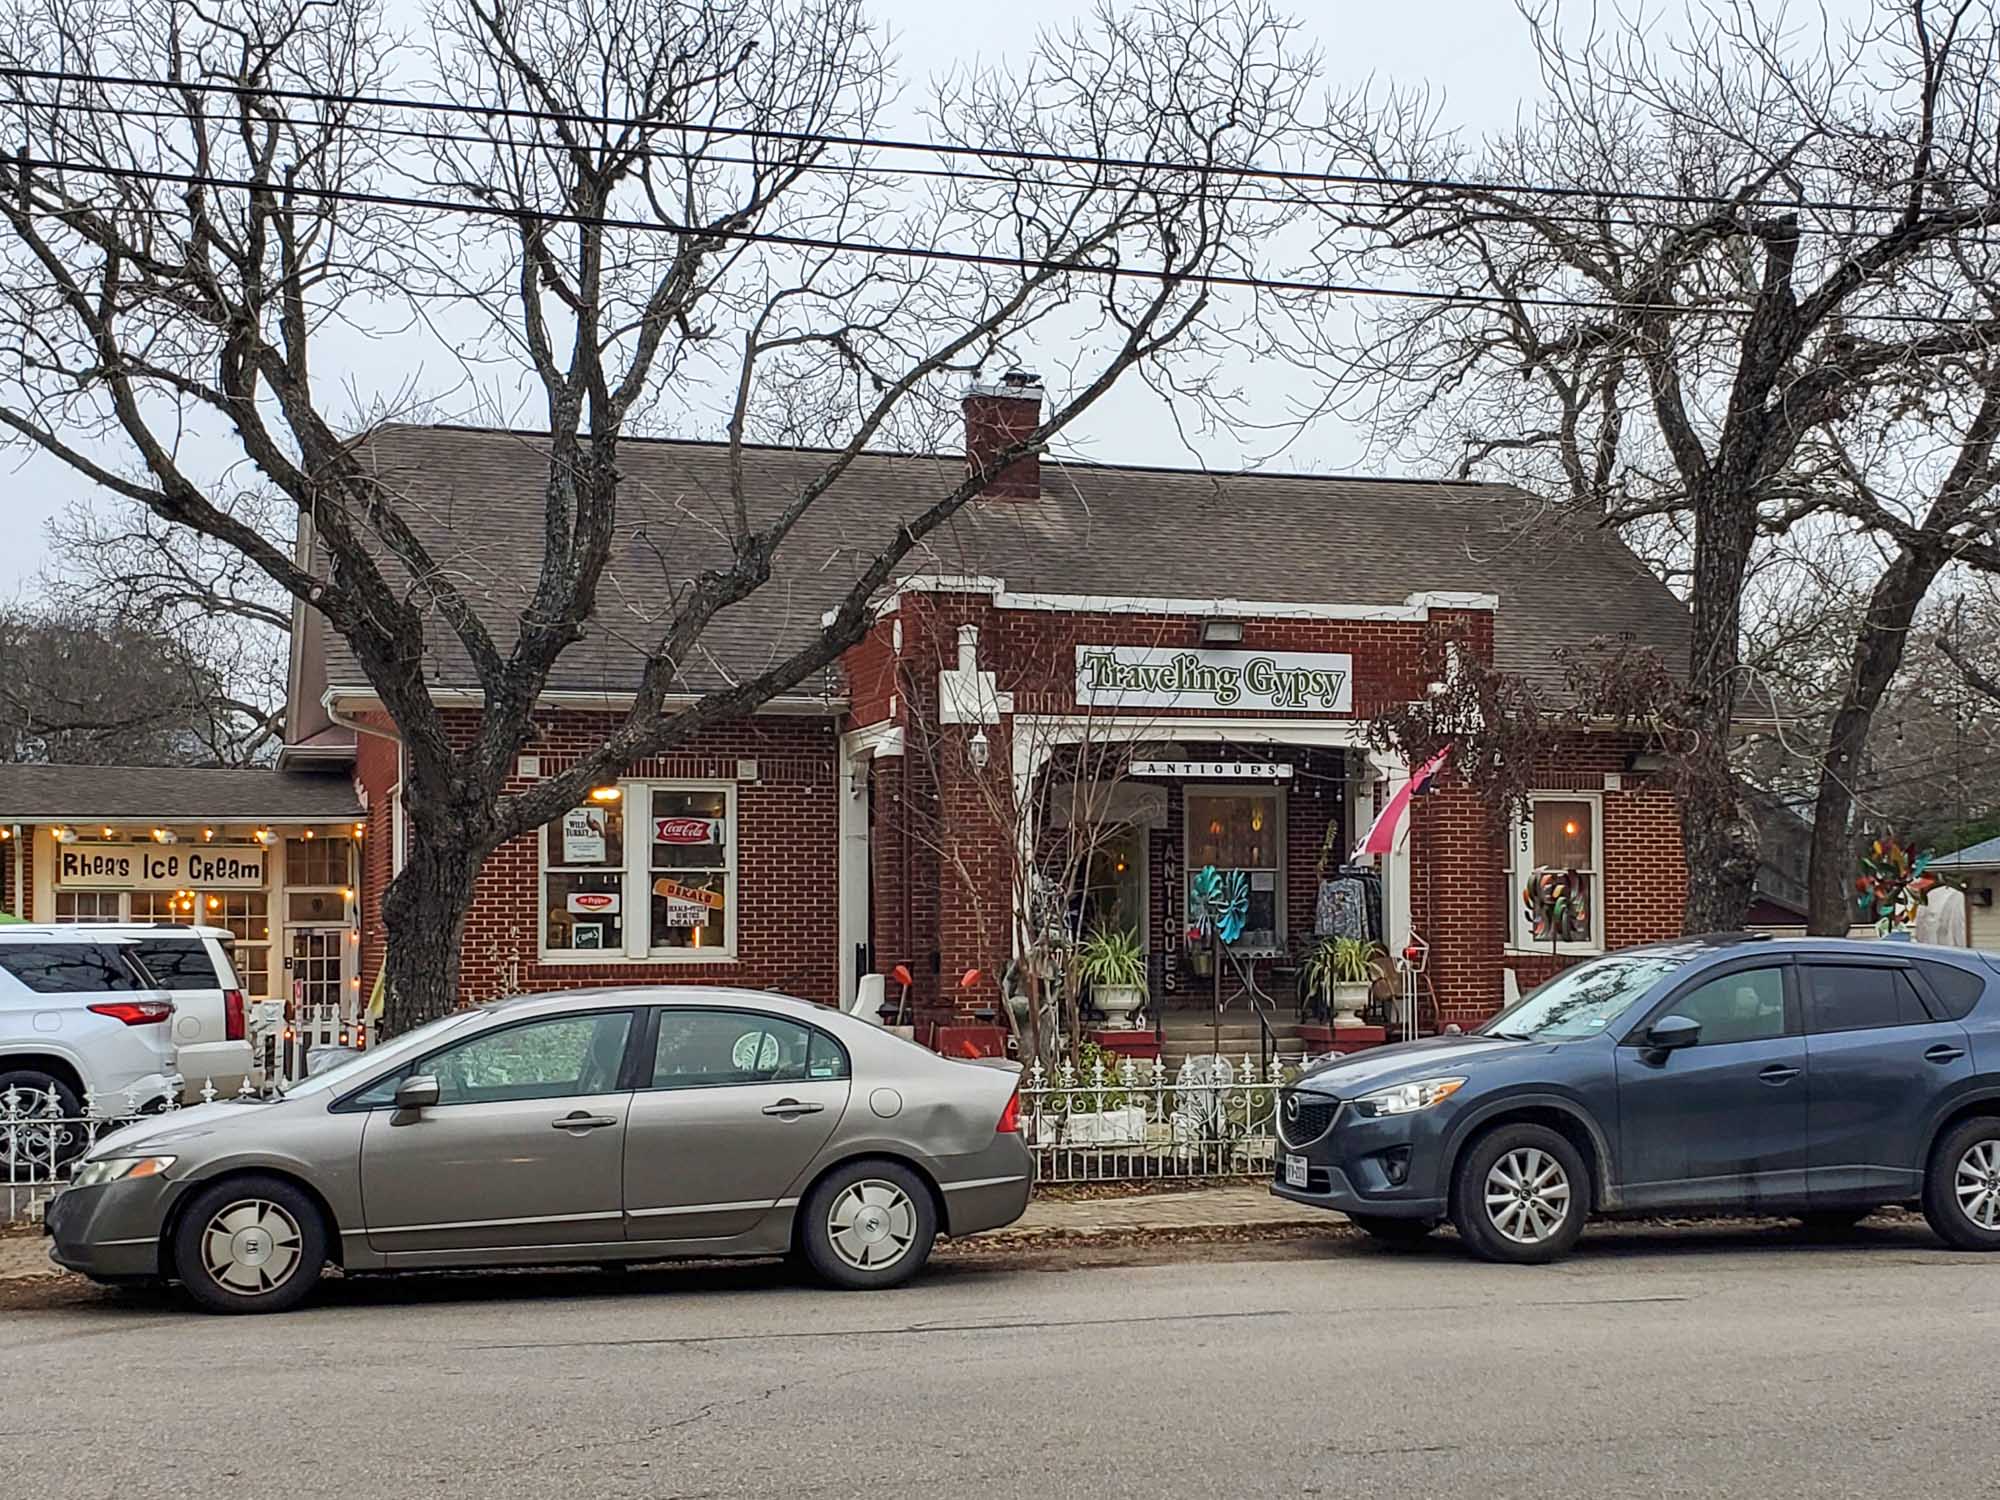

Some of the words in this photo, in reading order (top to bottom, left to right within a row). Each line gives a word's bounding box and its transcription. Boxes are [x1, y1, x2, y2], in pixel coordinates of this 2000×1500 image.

[1083, 651, 1241, 705] Traveling
[1244, 656, 1346, 708] Gypsy
[1147, 762, 1276, 776] ANTIQUES
[63, 853, 130, 877] Rhea's
[143, 853, 179, 879] Ice
[1164, 843, 1177, 990] ANTIQUES
